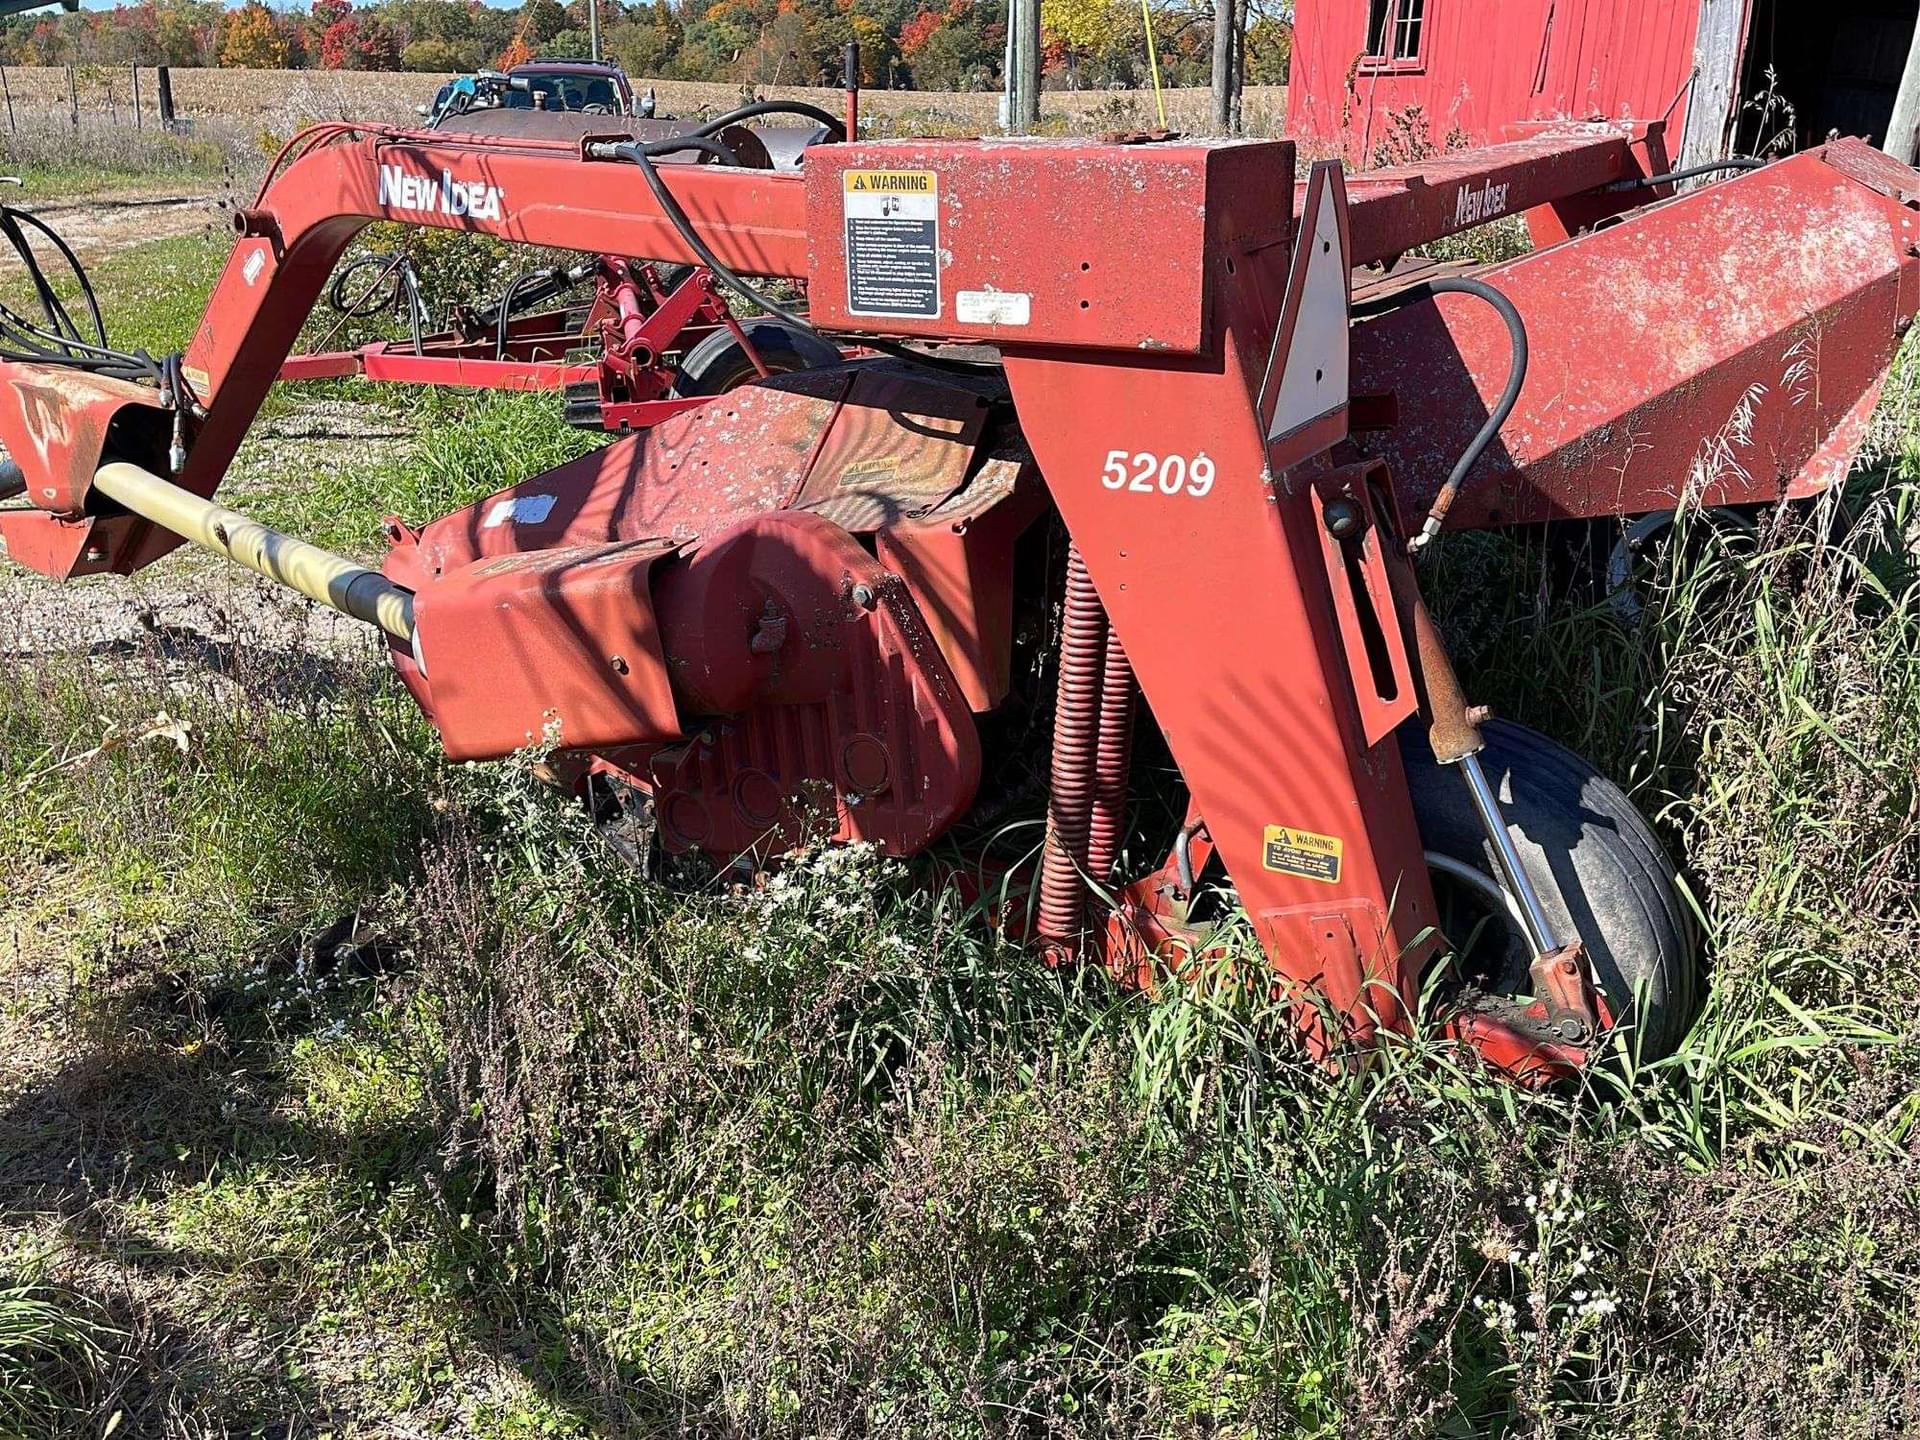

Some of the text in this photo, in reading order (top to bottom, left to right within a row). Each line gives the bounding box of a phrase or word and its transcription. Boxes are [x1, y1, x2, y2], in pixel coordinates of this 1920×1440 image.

[379, 164, 500, 221] NEW IDEA
[870, 175, 927, 190] WARNING
[1101, 450, 1216, 497] 5209
[1296, 834, 1334, 851] WARNING
